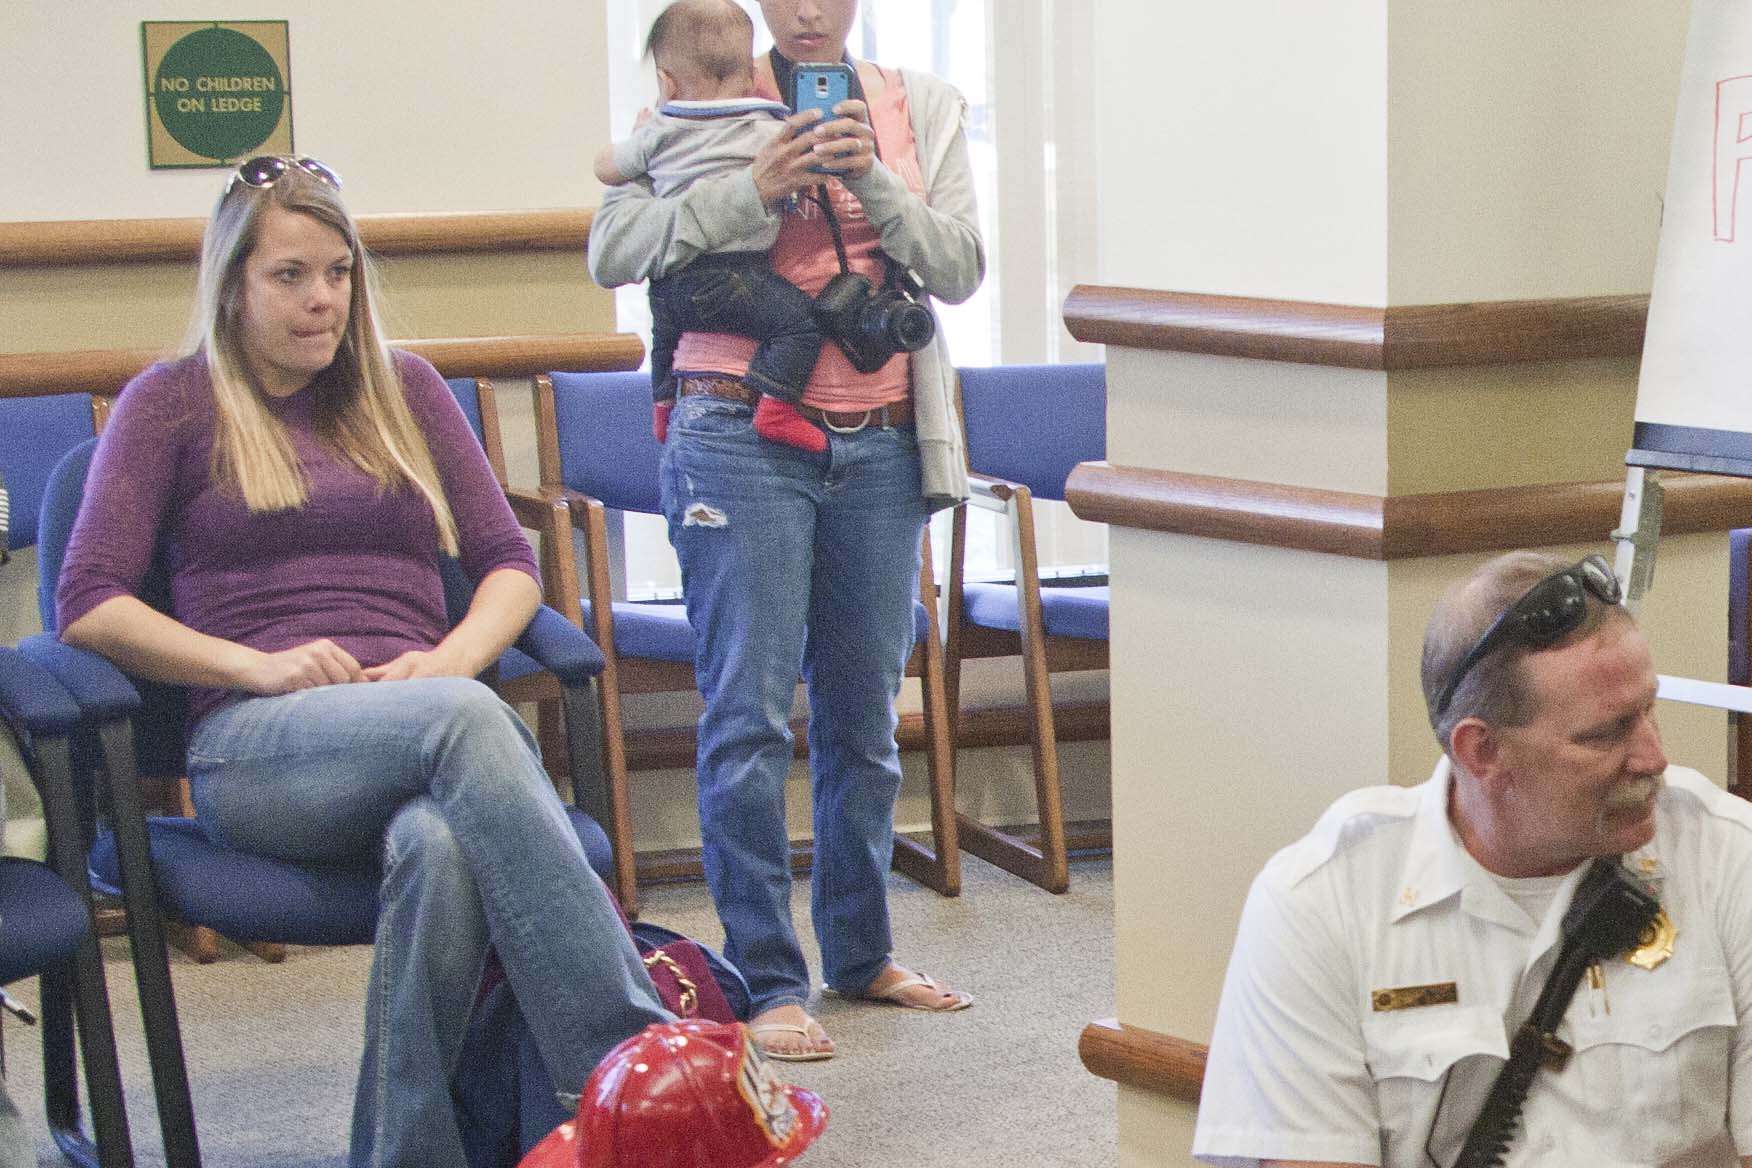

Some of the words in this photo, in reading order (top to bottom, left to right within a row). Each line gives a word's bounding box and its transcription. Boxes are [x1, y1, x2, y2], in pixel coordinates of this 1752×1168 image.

[161, 77, 190, 92] NO
[197, 77, 276, 92] CHILDREN
[176, 98, 205, 113] ON
[211, 98, 263, 113] LEDGE
